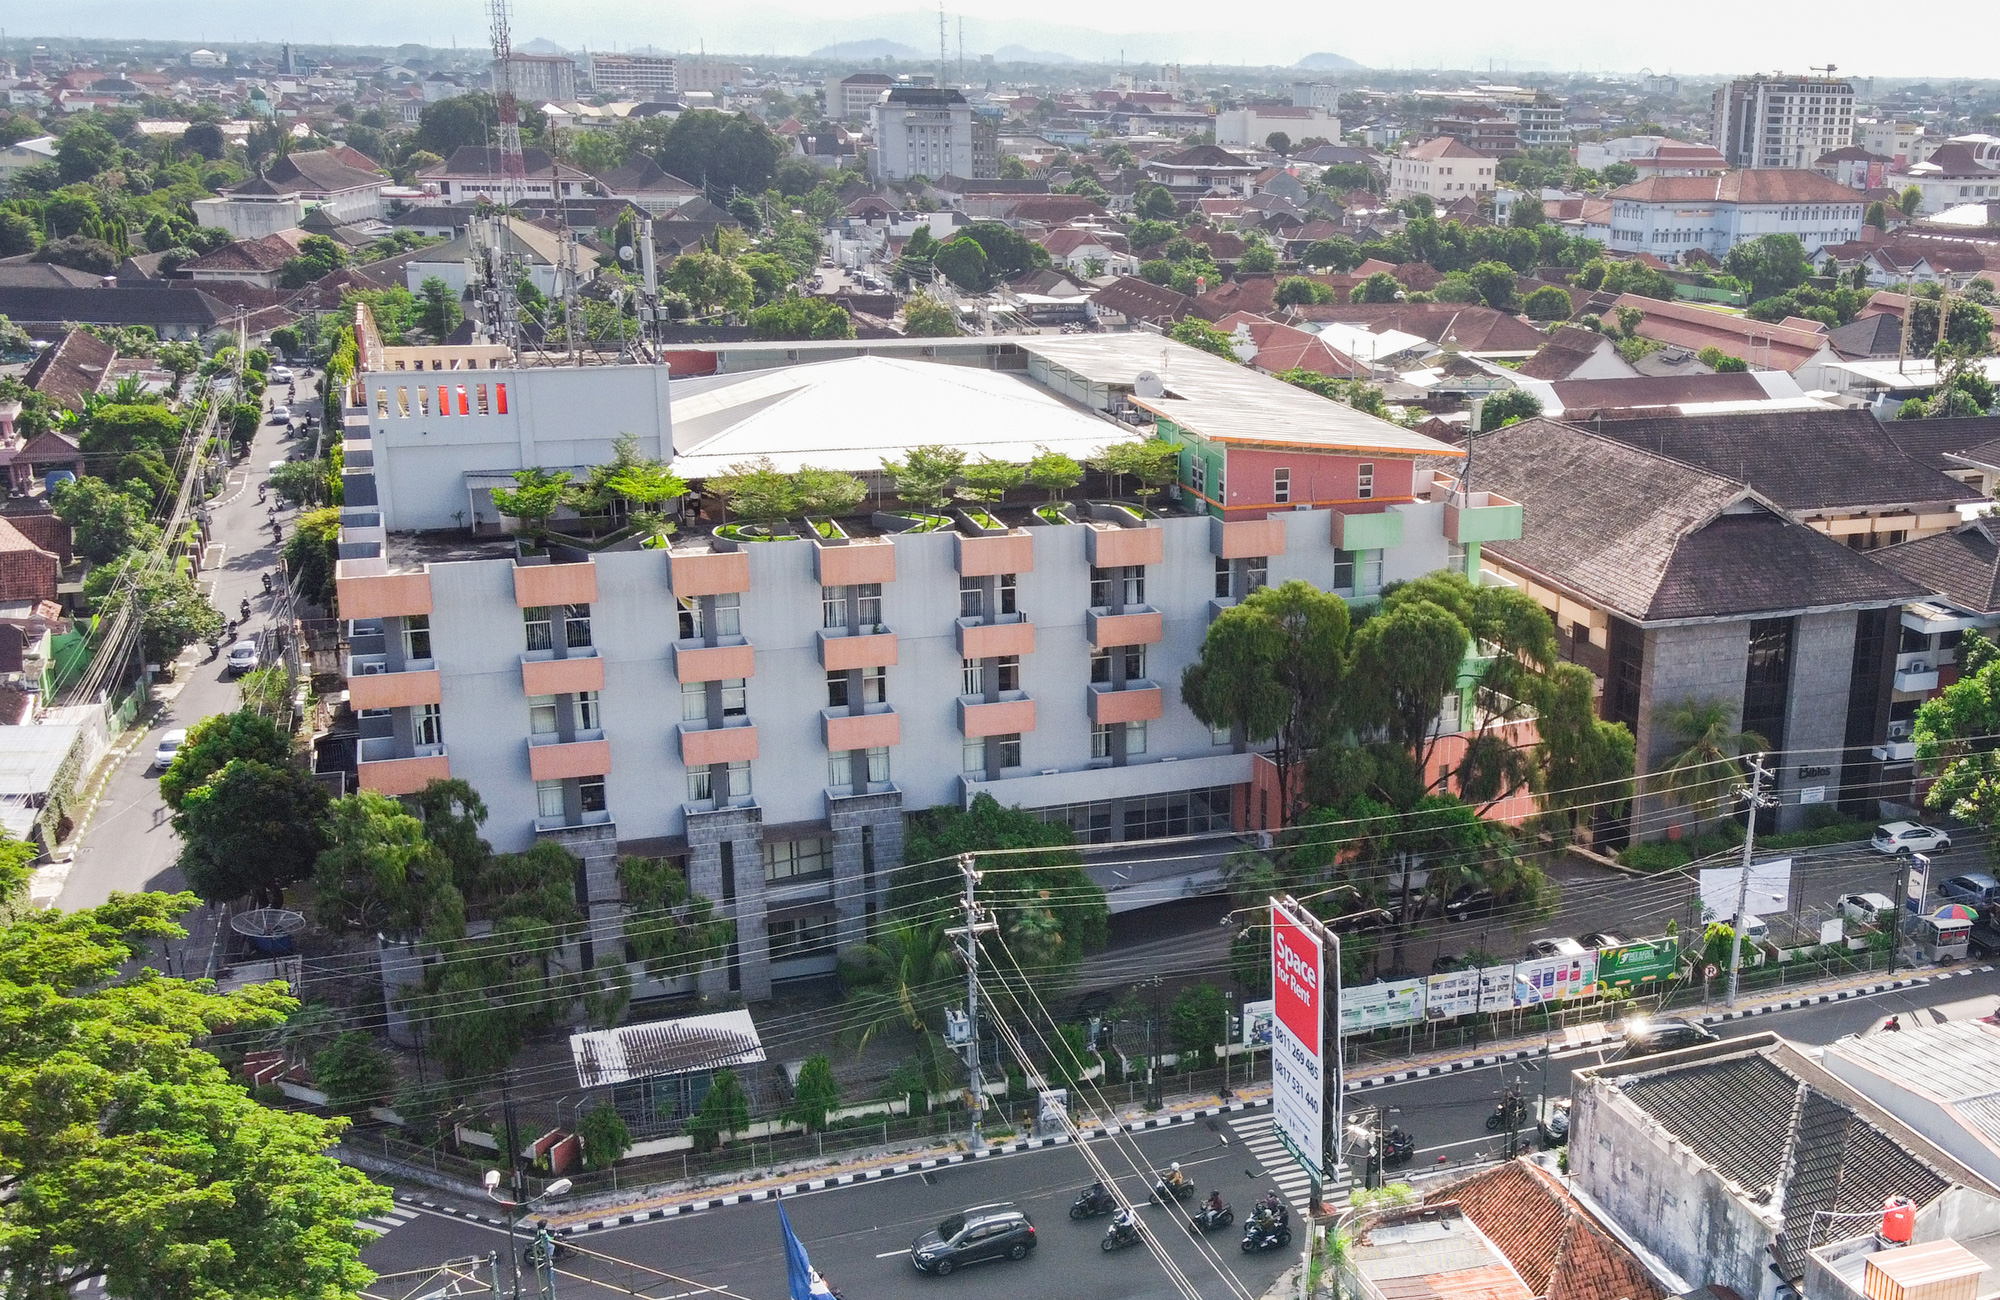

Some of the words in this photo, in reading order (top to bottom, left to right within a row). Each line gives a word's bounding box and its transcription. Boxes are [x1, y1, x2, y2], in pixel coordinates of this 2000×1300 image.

[1276, 932, 1316, 989] Space
[1277, 961, 1289, 985] for
[1290, 973, 1310, 1007] Rent
[1275, 1026, 1290, 1051] 0811
[1292, 1043, 1305, 1065] 269
[1305, 1059, 1319, 1080] 485
[1275, 1058, 1290, 1083] 0817
[1292, 1076, 1304, 1098] 531
[1305, 1092, 1319, 1114] 440
